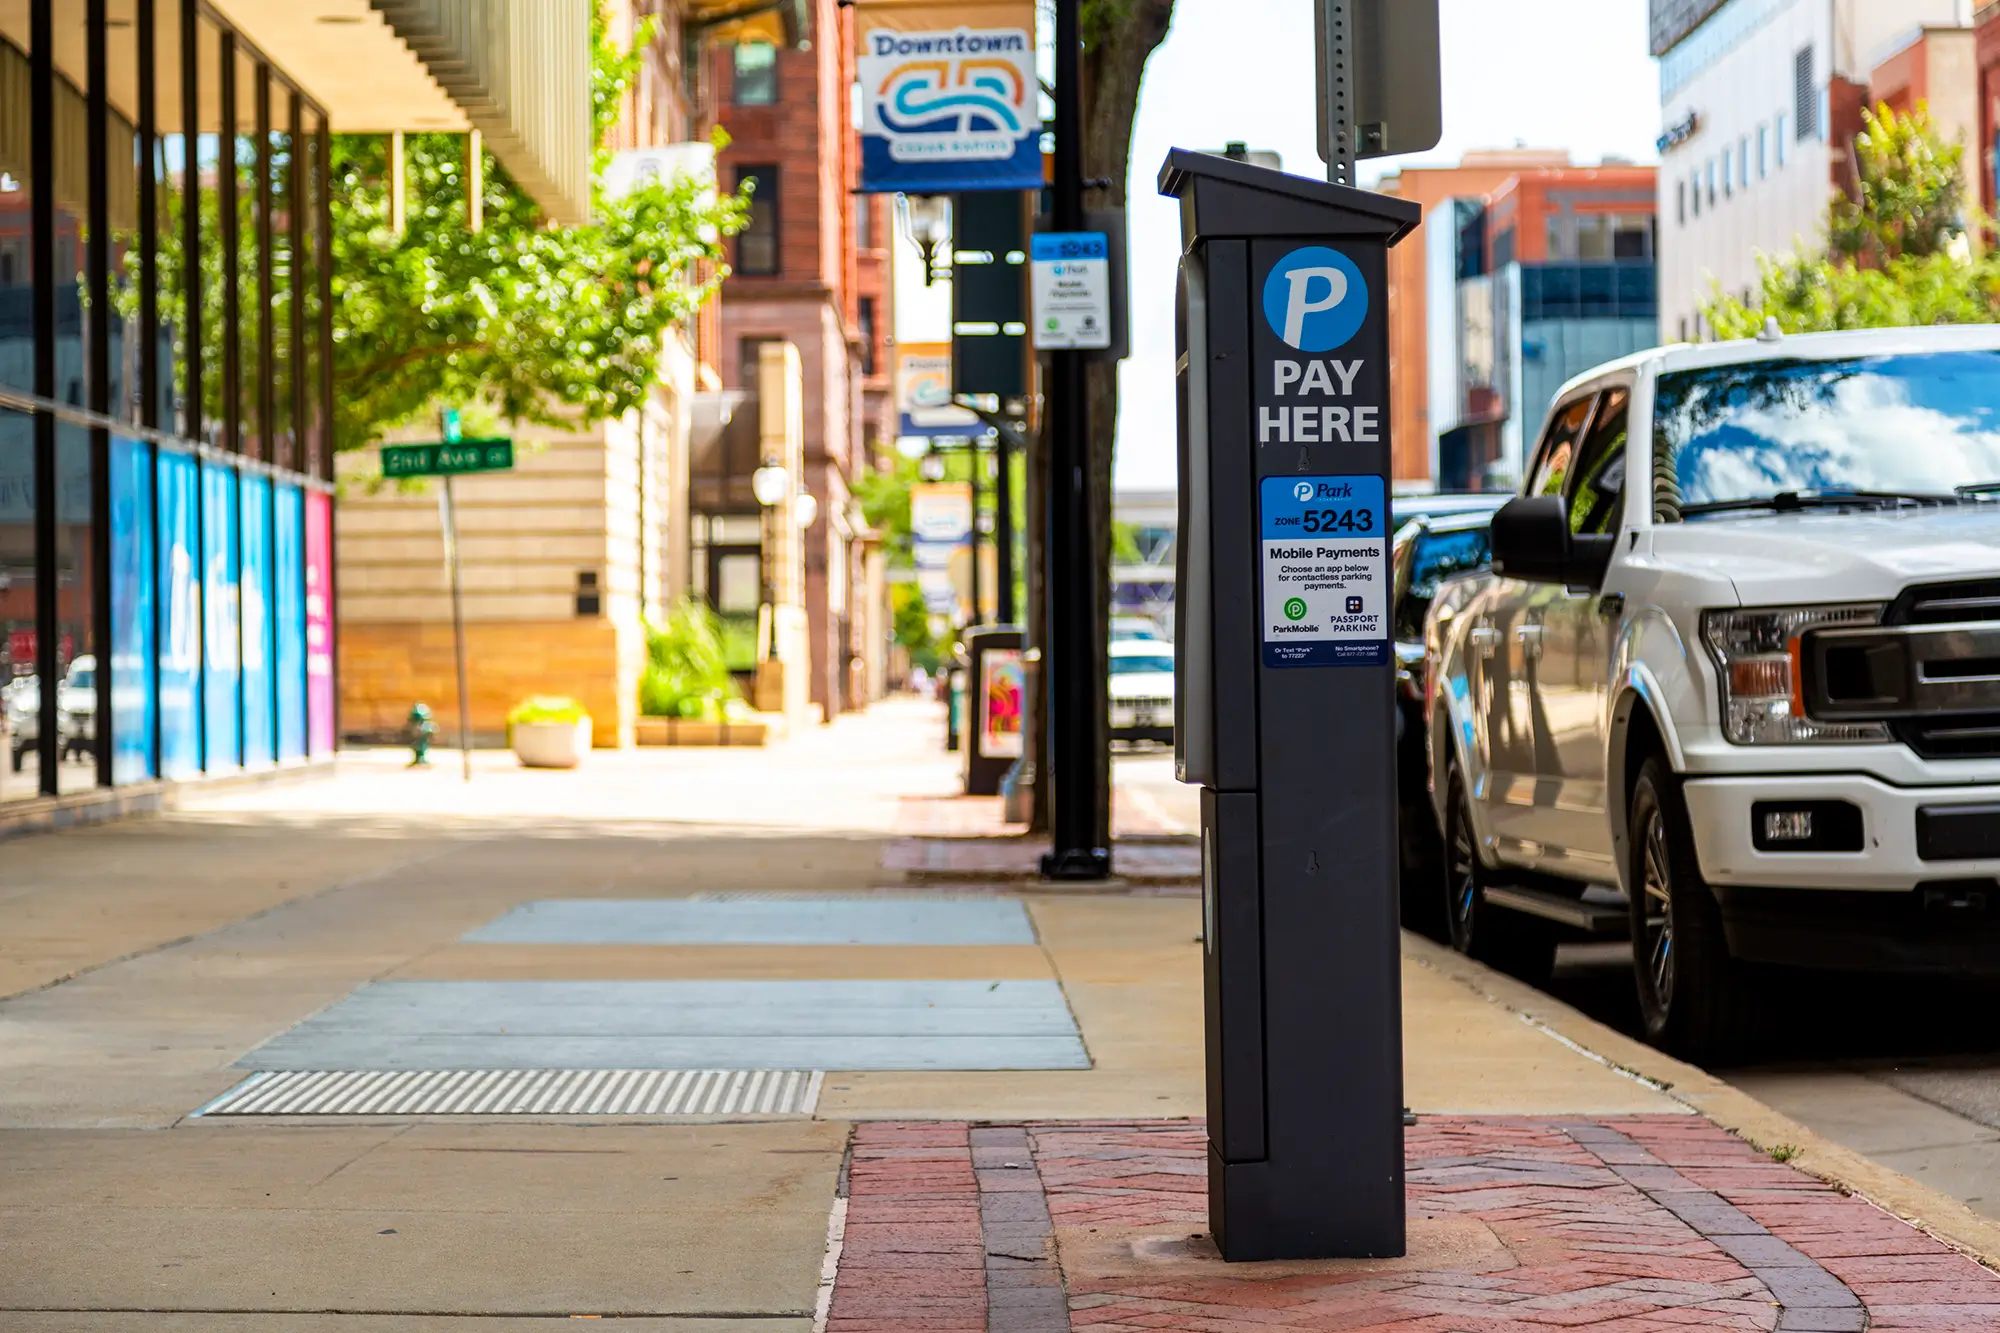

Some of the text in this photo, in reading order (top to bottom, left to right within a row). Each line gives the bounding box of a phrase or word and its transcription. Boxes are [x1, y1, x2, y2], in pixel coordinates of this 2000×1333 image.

[874, 33, 1023, 56] Downtown
[1274, 359, 1364, 396] PAY
[1259, 406, 1379, 442] HERE
[1316, 482, 1353, 498] Park
[1274, 508, 1373, 533] ZONE 5243
[1270, 547, 1380, 560] Mobile Payments
[1281, 565, 1313, 573] Choose
[1344, 564, 1369, 572] below
[1292, 573, 1339, 581] contactless
[1341, 573, 1372, 581] parking
[1304, 582, 1347, 591] payments.
[1330, 615, 1379, 623] PASSPORT
[1273, 625, 1319, 633] ParkMobile
[1333, 624, 1377, 632] PARKING
